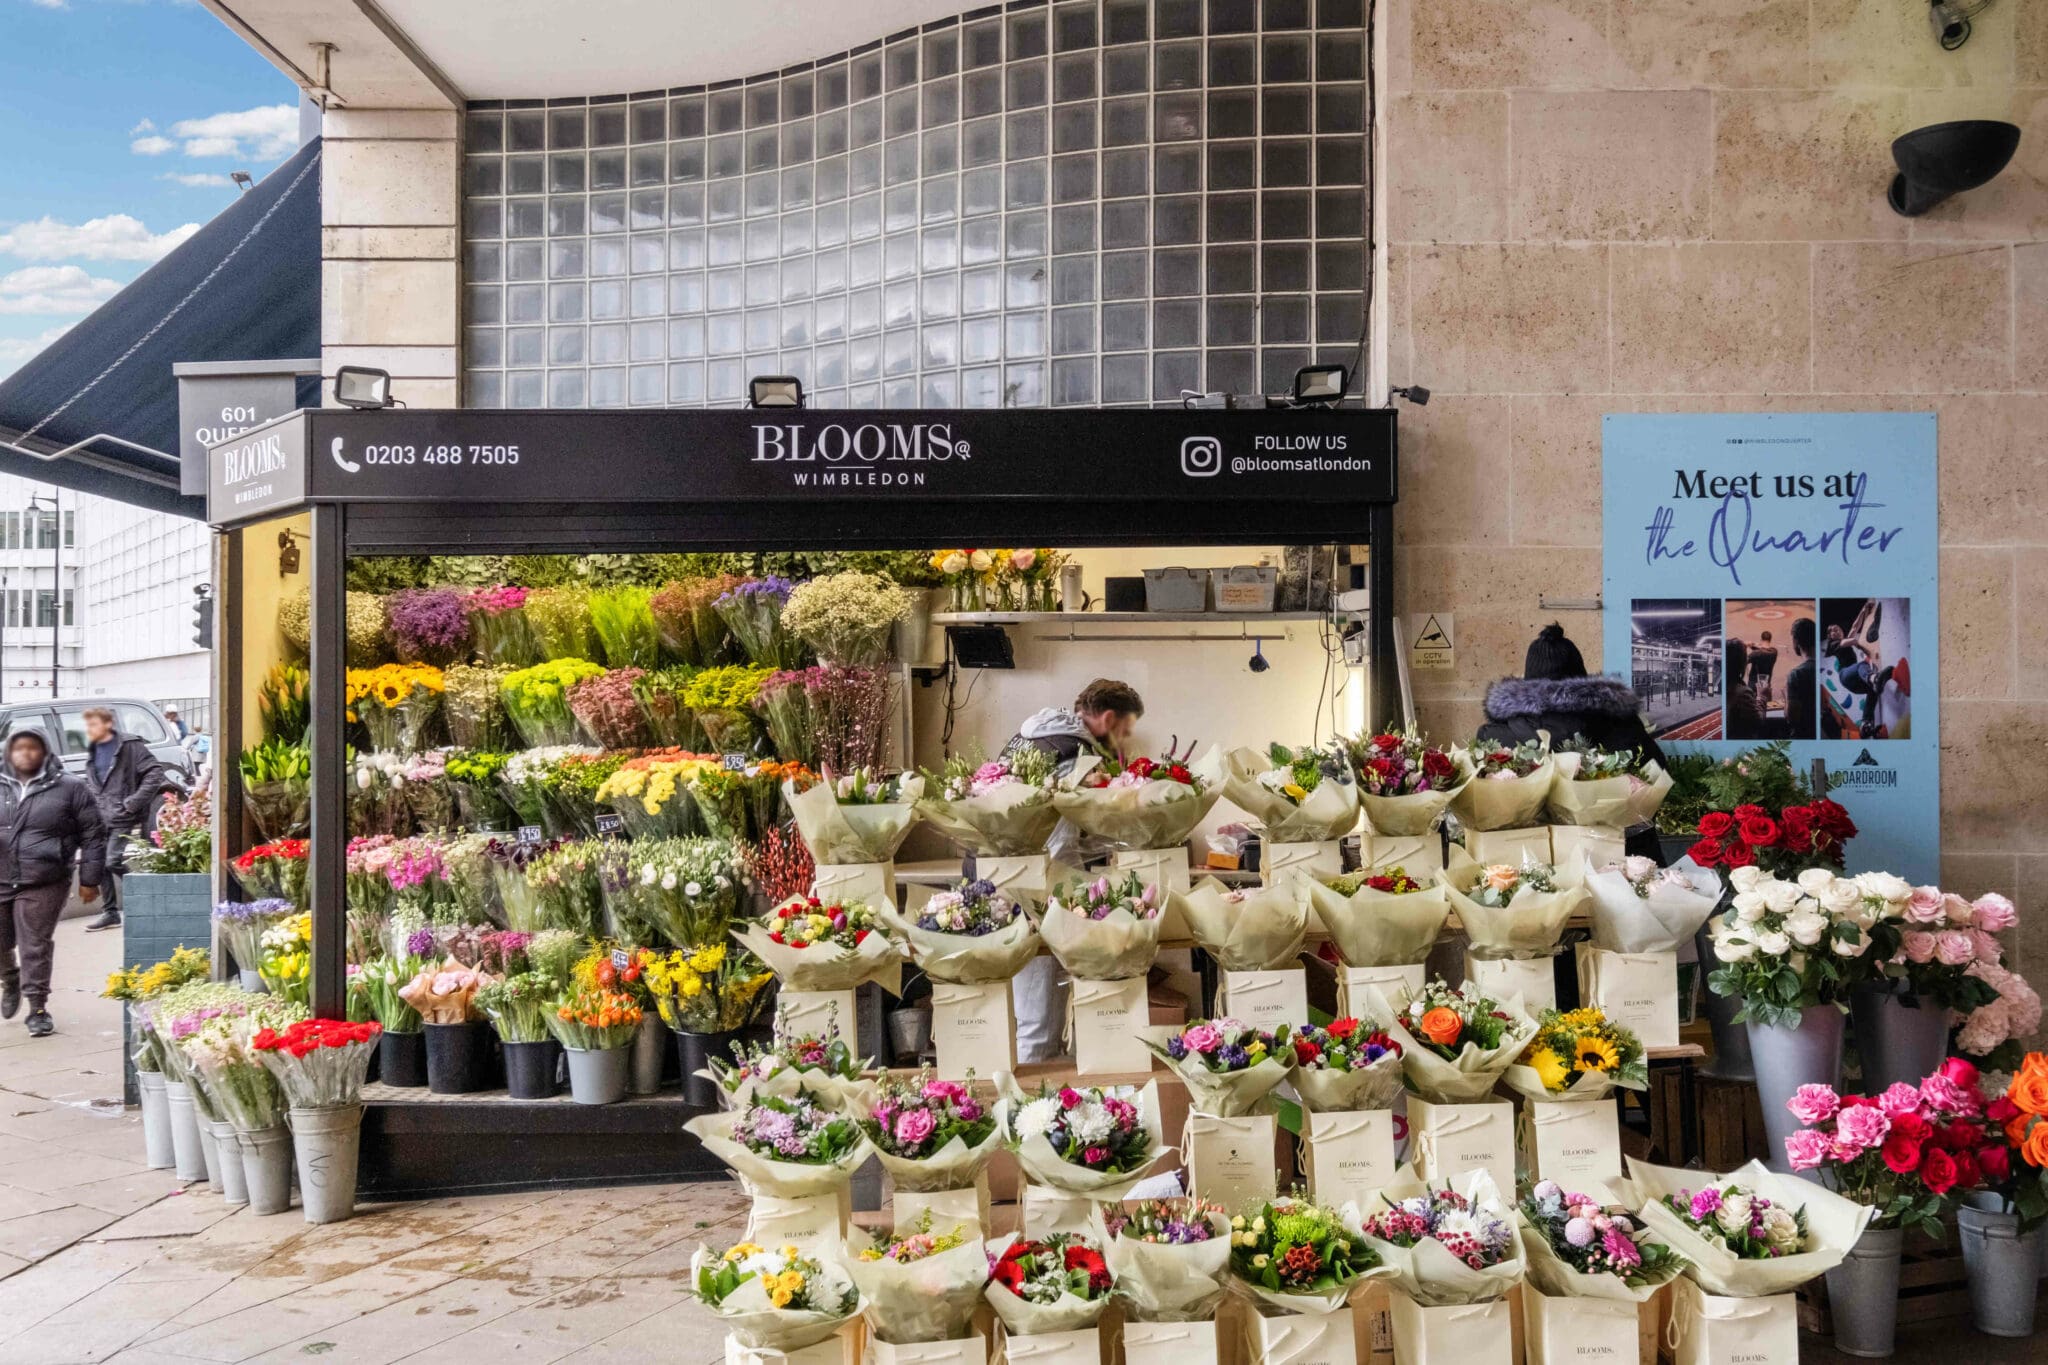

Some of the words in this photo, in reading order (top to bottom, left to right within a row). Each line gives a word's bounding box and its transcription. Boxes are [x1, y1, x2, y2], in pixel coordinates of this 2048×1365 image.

[221, 406, 255, 423] 601
[1255, 436, 1321, 450] FOLLOW
[1325, 436, 1347, 450] US
[365, 445, 416, 465] 0203
[422, 445, 462, 465] 488
[469, 445, 520, 465] 7505
[1231, 456, 1371, 474] @bloomsatlondon
[794, 472, 925, 485] WIMBLEDON
[1672, 469, 1763, 499] Meet
[1774, 473, 1815, 499] us
[1823, 471, 1858, 499] at
[1645, 506, 1698, 565] the
[1708, 472, 1903, 586] Quarter
